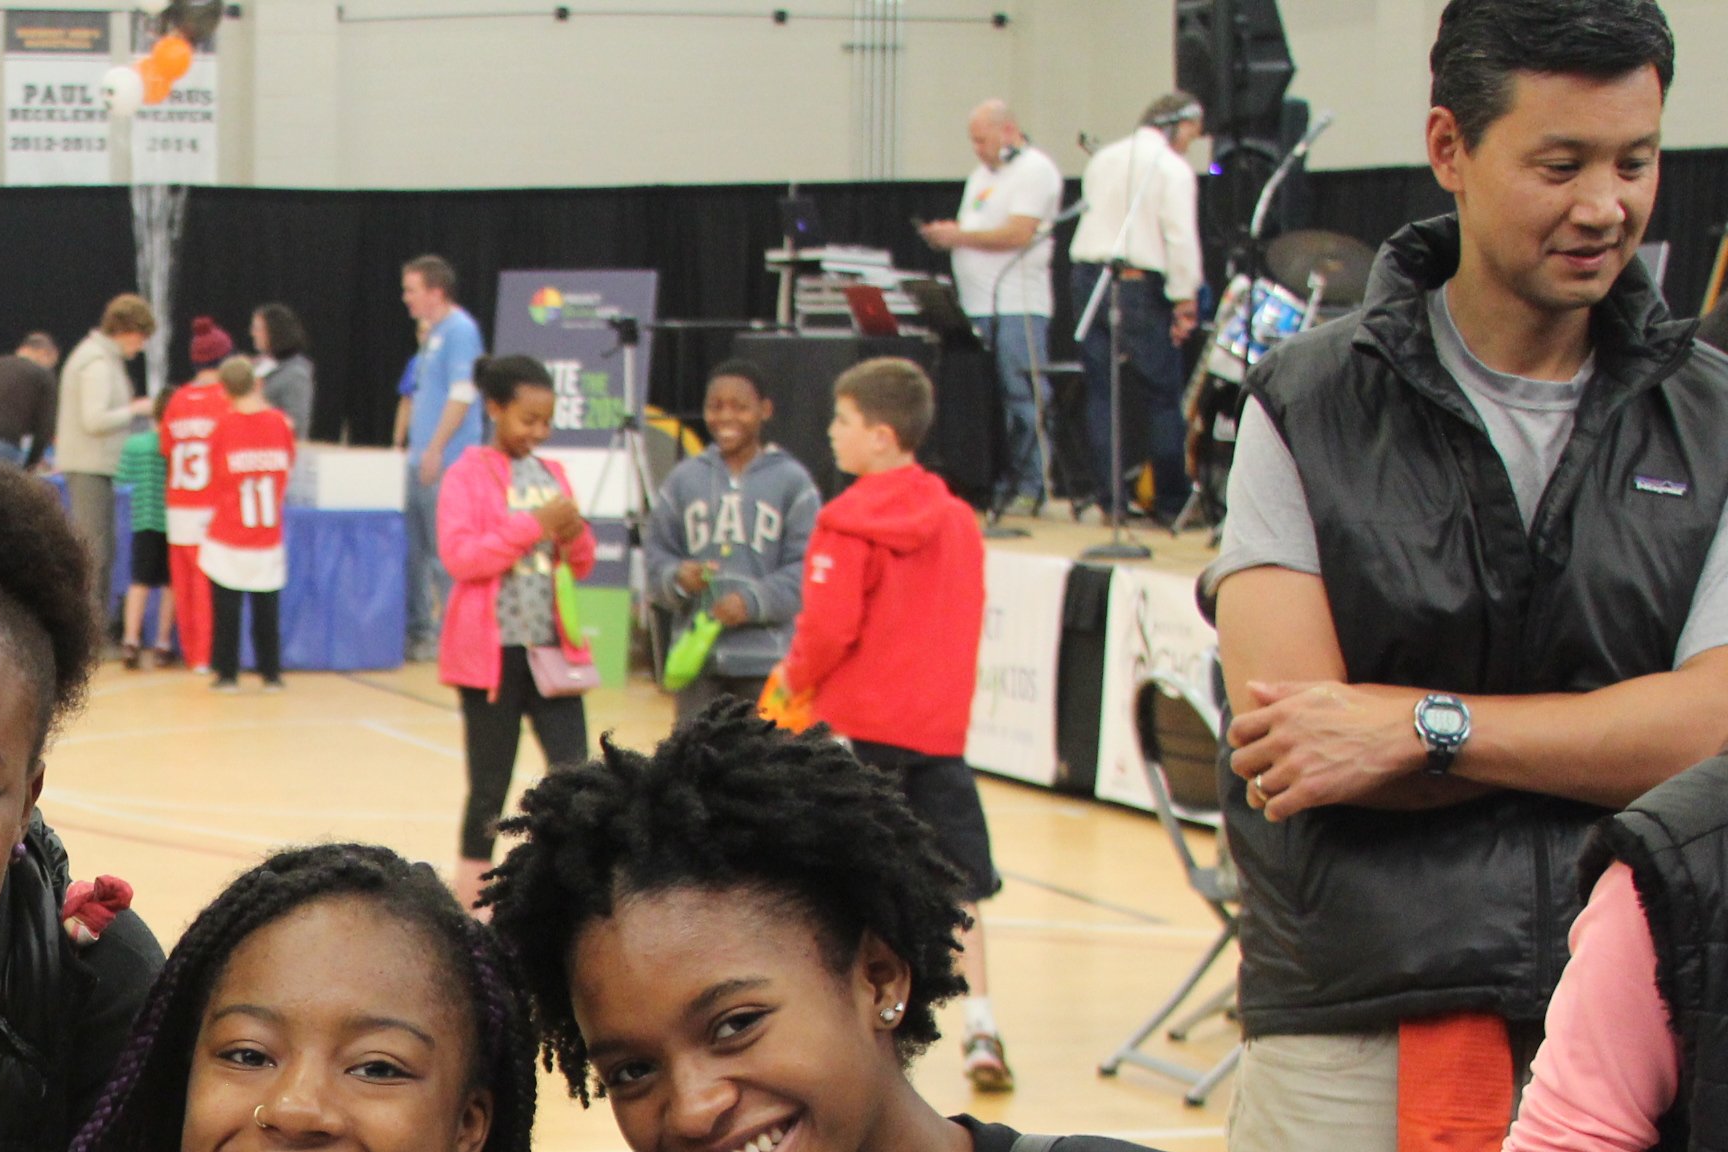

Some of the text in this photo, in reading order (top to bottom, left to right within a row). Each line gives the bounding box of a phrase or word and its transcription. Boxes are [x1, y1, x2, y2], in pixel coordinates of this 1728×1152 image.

[24, 85, 93, 104] PAUL
[170, 440, 211, 491] 13
[239, 475, 277, 529] 11
[684, 492, 783, 555] GAP
